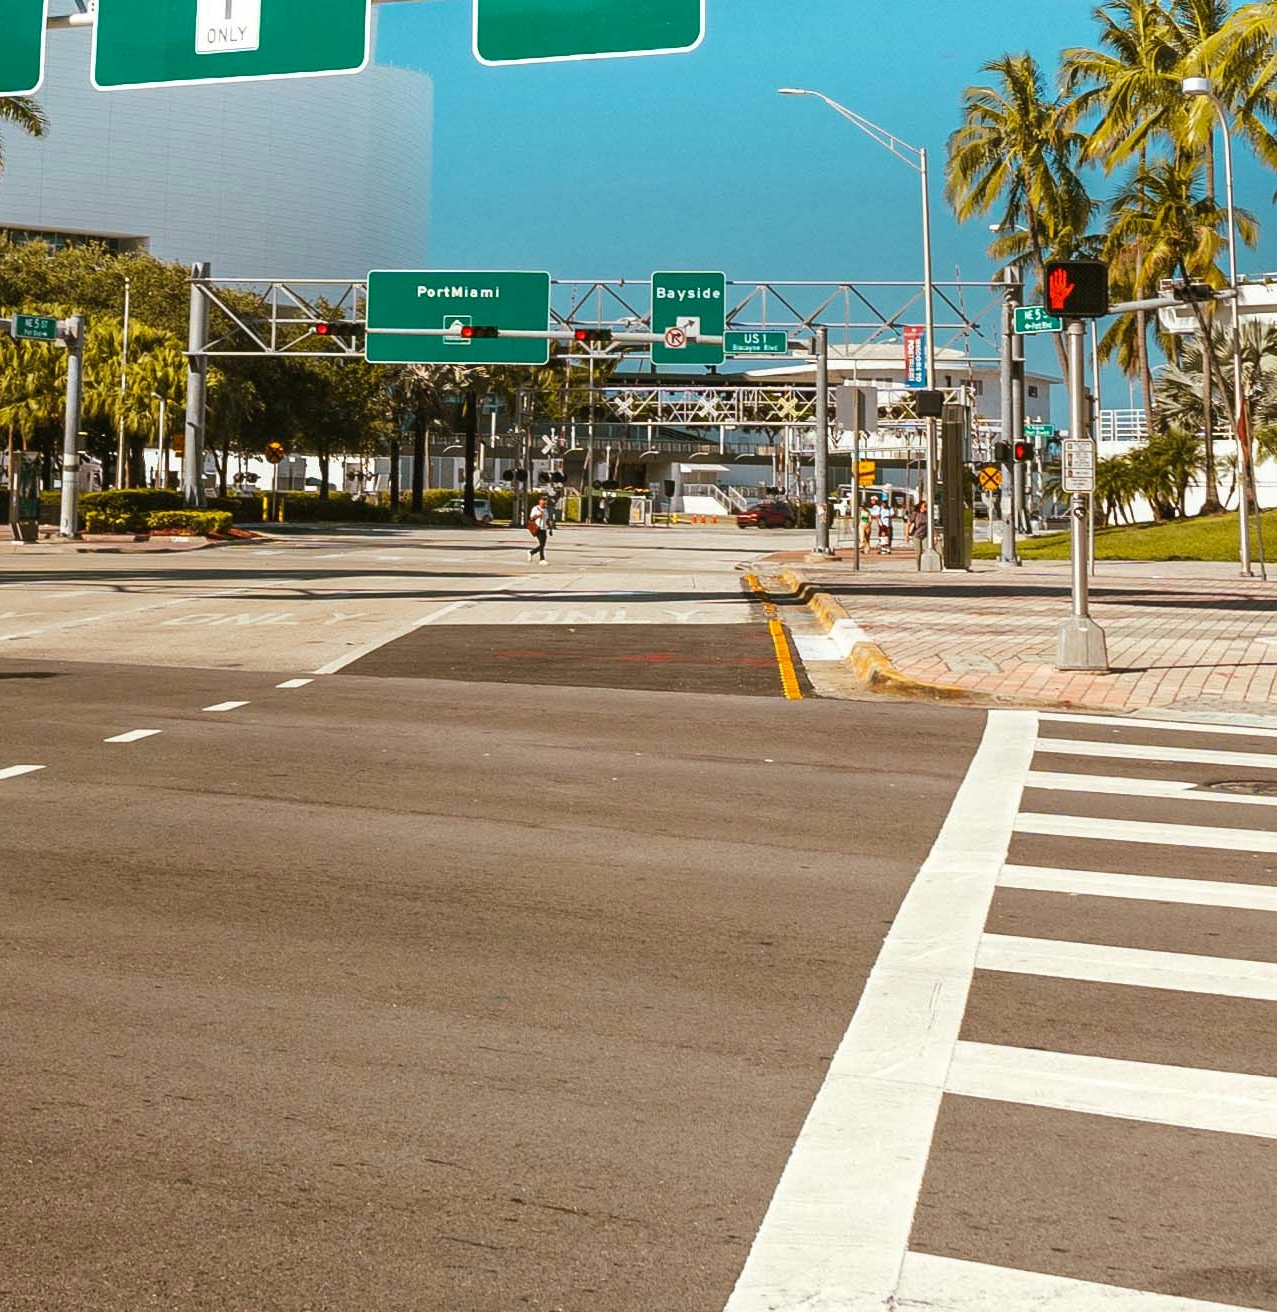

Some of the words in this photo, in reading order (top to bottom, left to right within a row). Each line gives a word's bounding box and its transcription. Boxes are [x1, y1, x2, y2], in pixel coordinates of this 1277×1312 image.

[206, 24, 248, 45] ONLY
[656, 287, 721, 302] Bayside
[744, 333, 760, 344] US
[762, 333, 767, 344] 1
